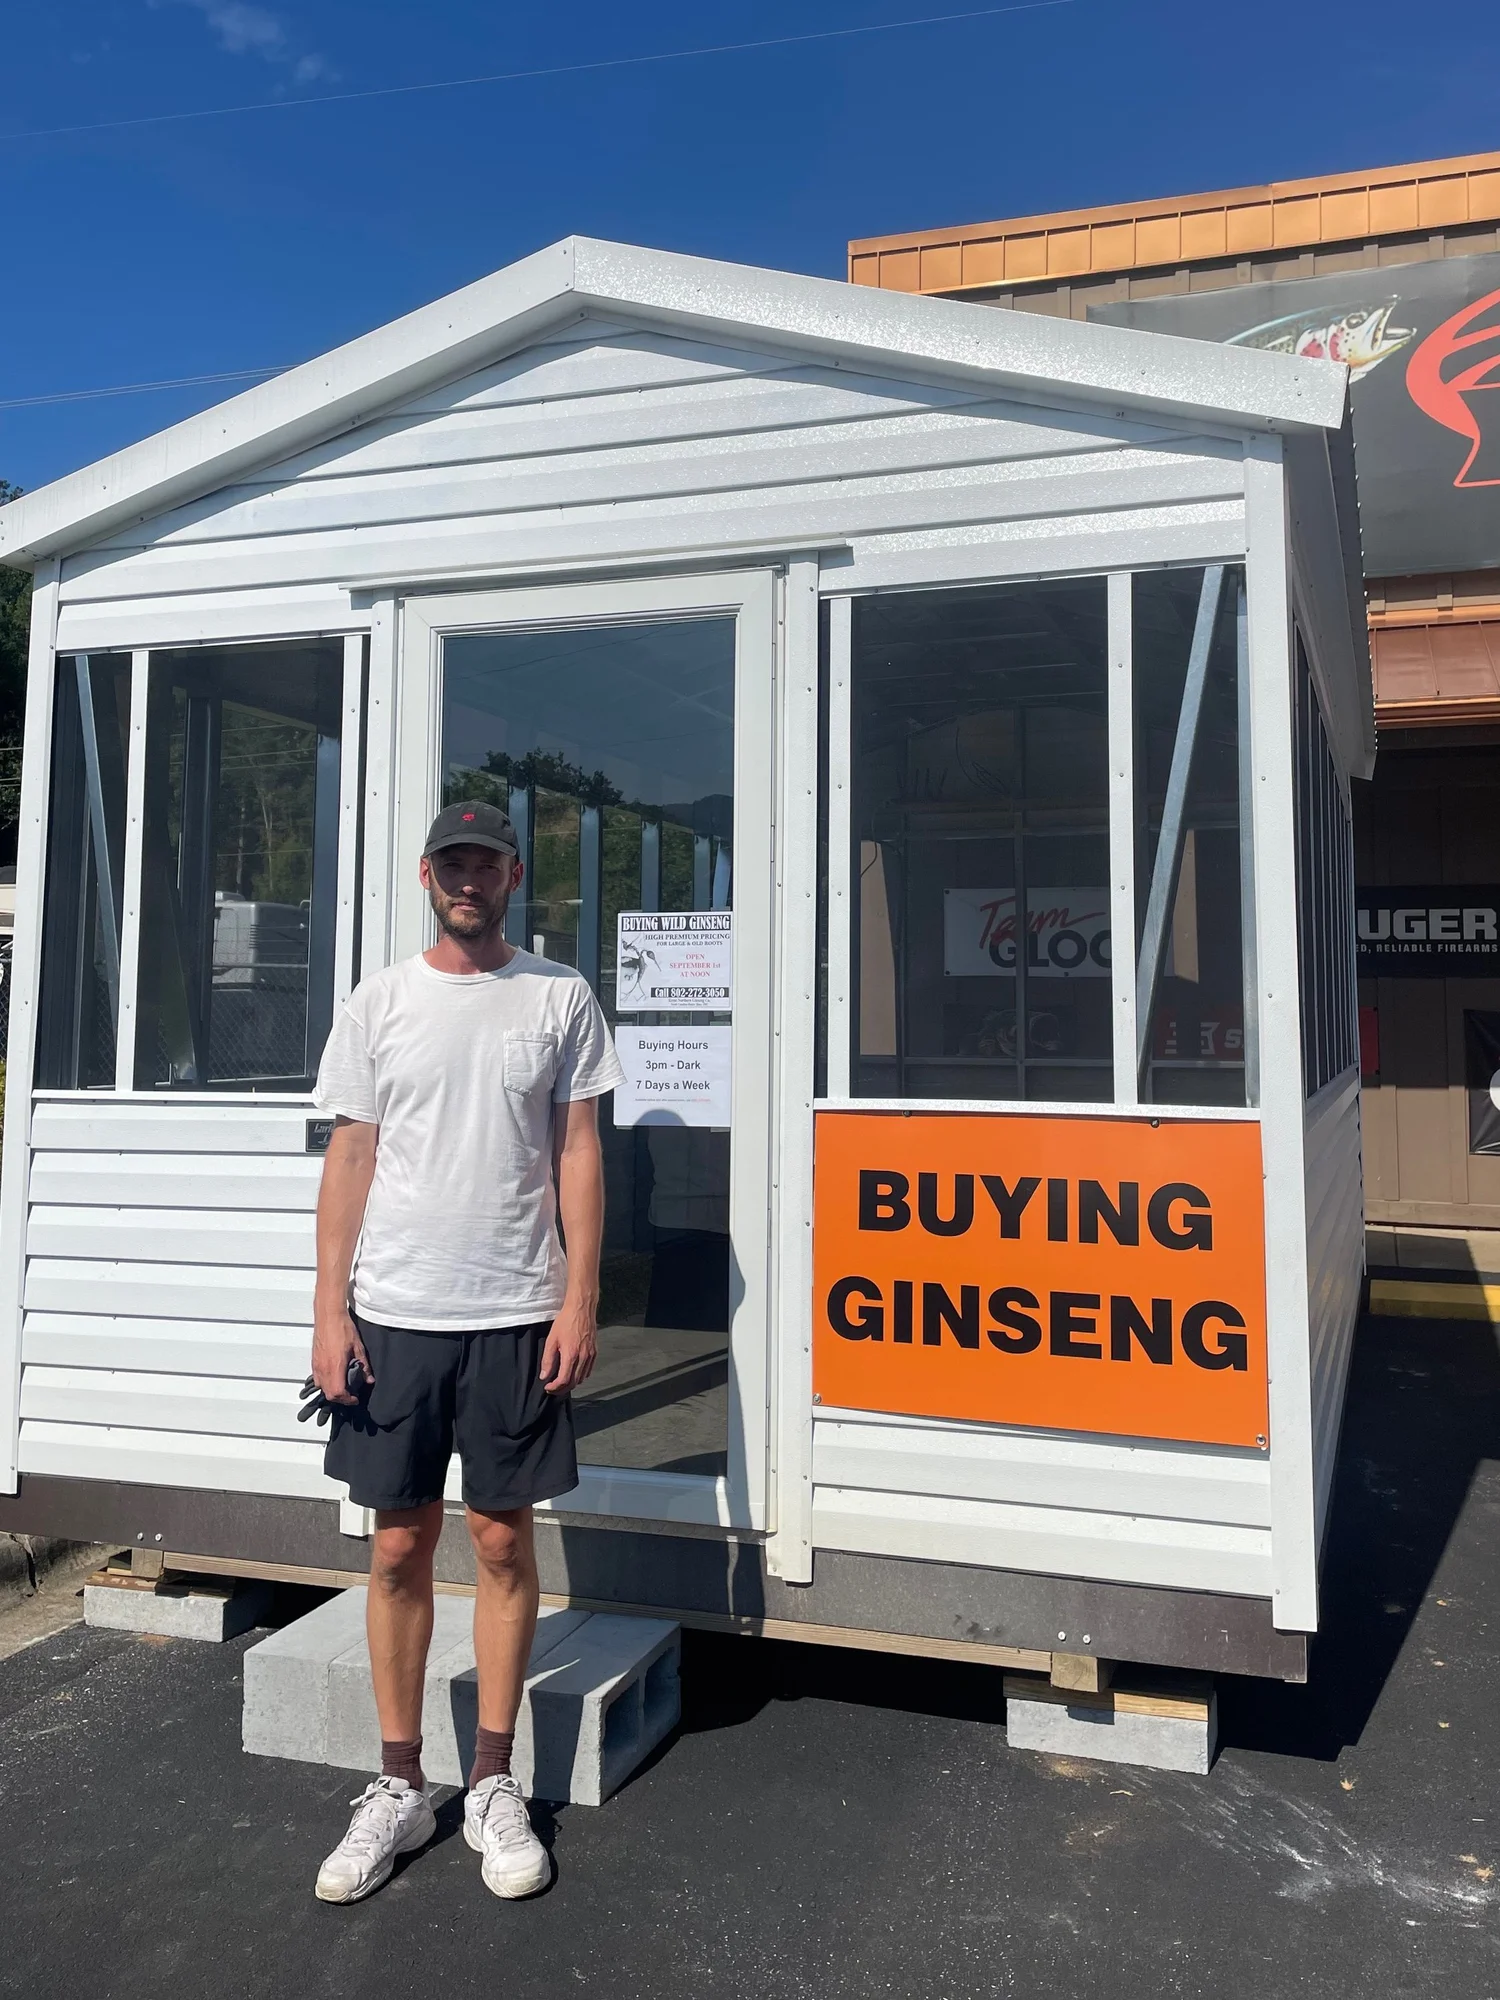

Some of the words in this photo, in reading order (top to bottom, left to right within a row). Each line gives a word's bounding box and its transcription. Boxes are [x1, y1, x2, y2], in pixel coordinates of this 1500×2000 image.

[622, 917, 659, 931] BUYING
[661, 917, 687, 930] WILD
[689, 915, 730, 930] GINSENG
[1357, 908, 1498, 940] UGER
[989, 929, 1112, 969] GLOC
[1376, 943, 1432, 953] RELIABLE
[1437, 943, 1498, 953] FIREARMS
[654, 988, 669, 997] Call
[638, 1040, 675, 1052] Buying
[677, 1040, 709, 1050] Hours
[645, 1060, 668, 1072] 3pm
[677, 1060, 701, 1070] Dark
[636, 1080, 642, 1090] 7
[645, 1080, 671, 1092] Days
[682, 1080, 710, 1090] Week
[858, 1169, 1213, 1251] BUYING
[827, 1275, 1248, 1371] GINSENG
